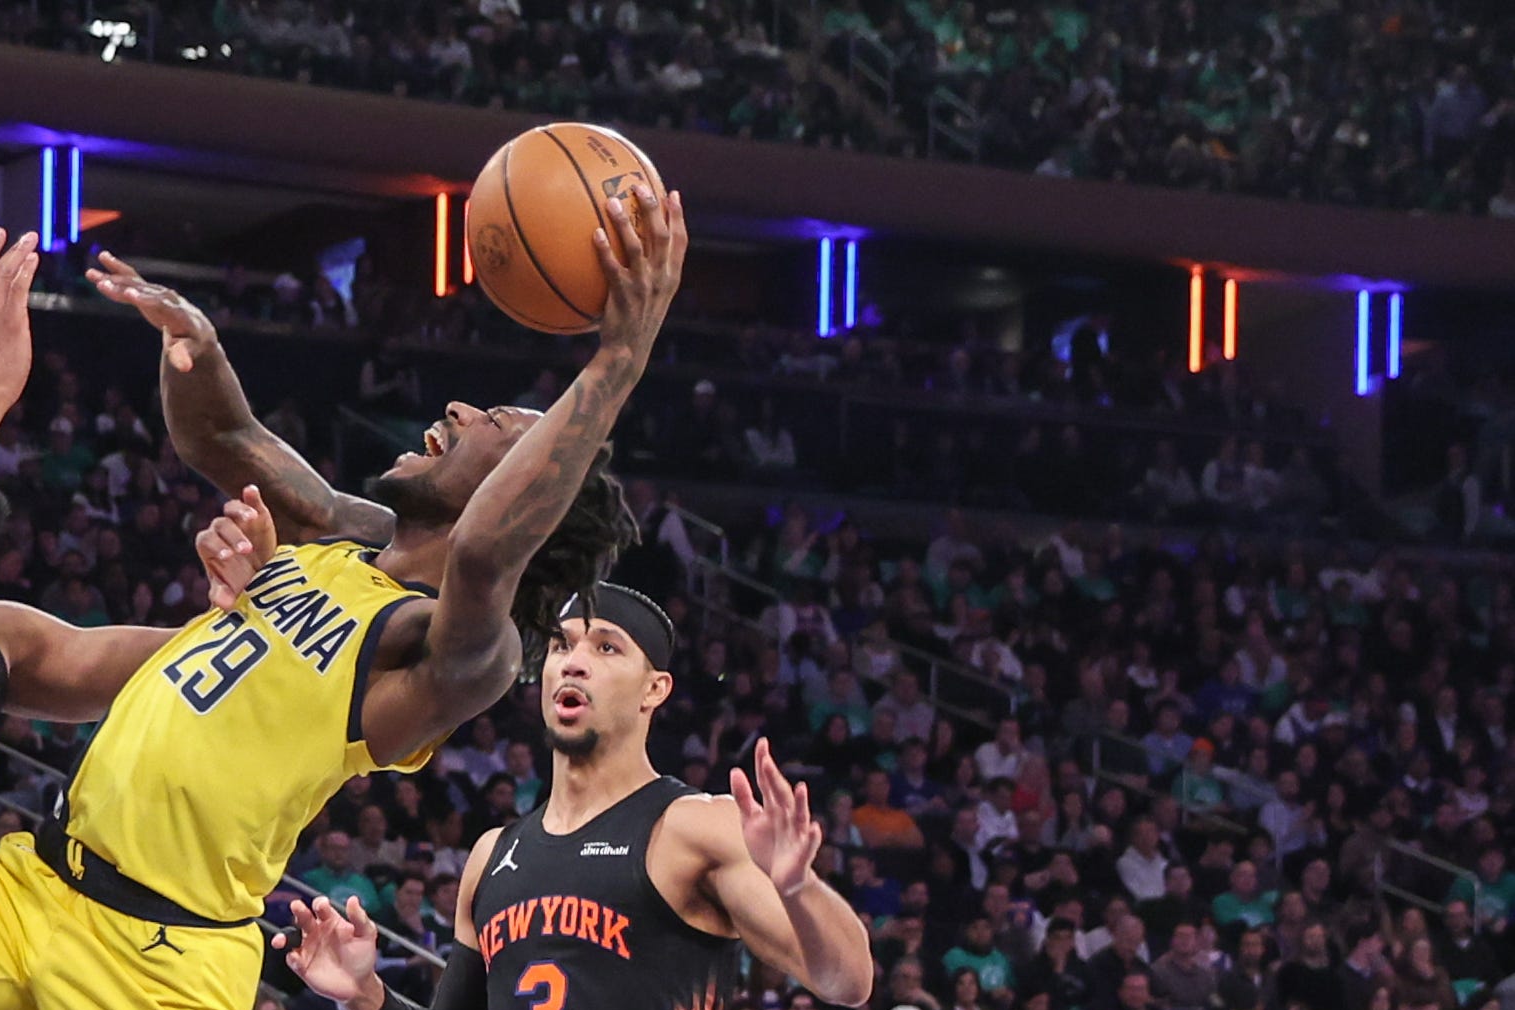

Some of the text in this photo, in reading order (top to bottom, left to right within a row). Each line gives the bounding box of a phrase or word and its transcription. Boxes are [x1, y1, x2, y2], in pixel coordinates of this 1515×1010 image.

[162, 611, 269, 714] 29
[478, 895, 631, 974] NEW YORK
